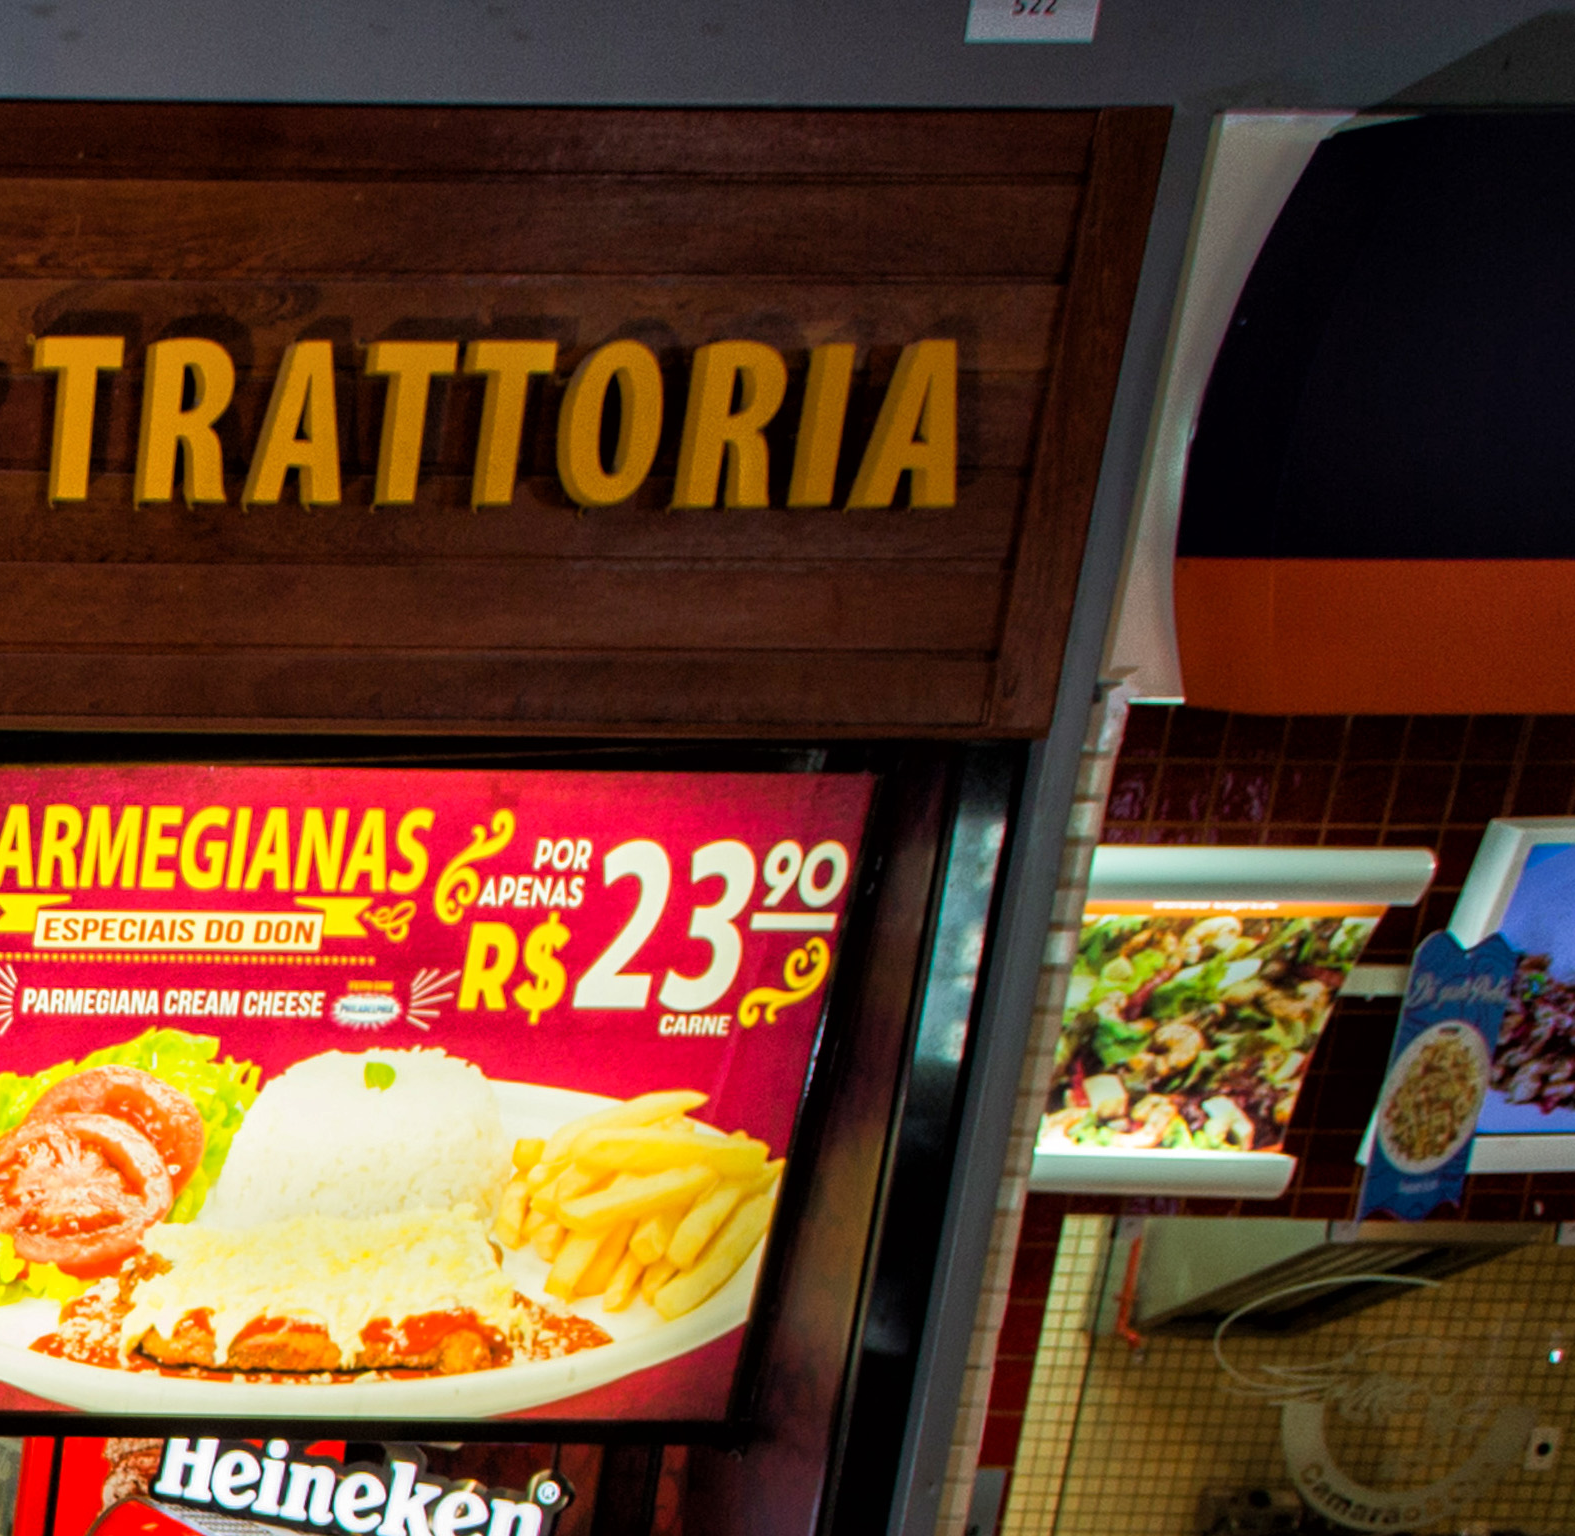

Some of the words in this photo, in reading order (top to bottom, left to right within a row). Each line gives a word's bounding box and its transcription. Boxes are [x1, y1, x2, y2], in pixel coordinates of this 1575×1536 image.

[31, 333, 961, 510] TRATTORIA
[533, 838, 593, 871] POR
[476, 875, 586, 909] APENAS
[42, 917, 195, 944] ESPECIAIS
[203, 918, 246, 945] DO
[252, 919, 316, 946] DON
[457, 911, 572, 1026] R$
[572, 837, 758, 1012] 23
[762, 838, 850, 909] 90
[20, 987, 159, 1017] PARMEGIANA
[161, 989, 240, 1018] CREAM
[242, 989, 327, 1019] CHEESE
[658, 1013, 733, 1037] CARNE
